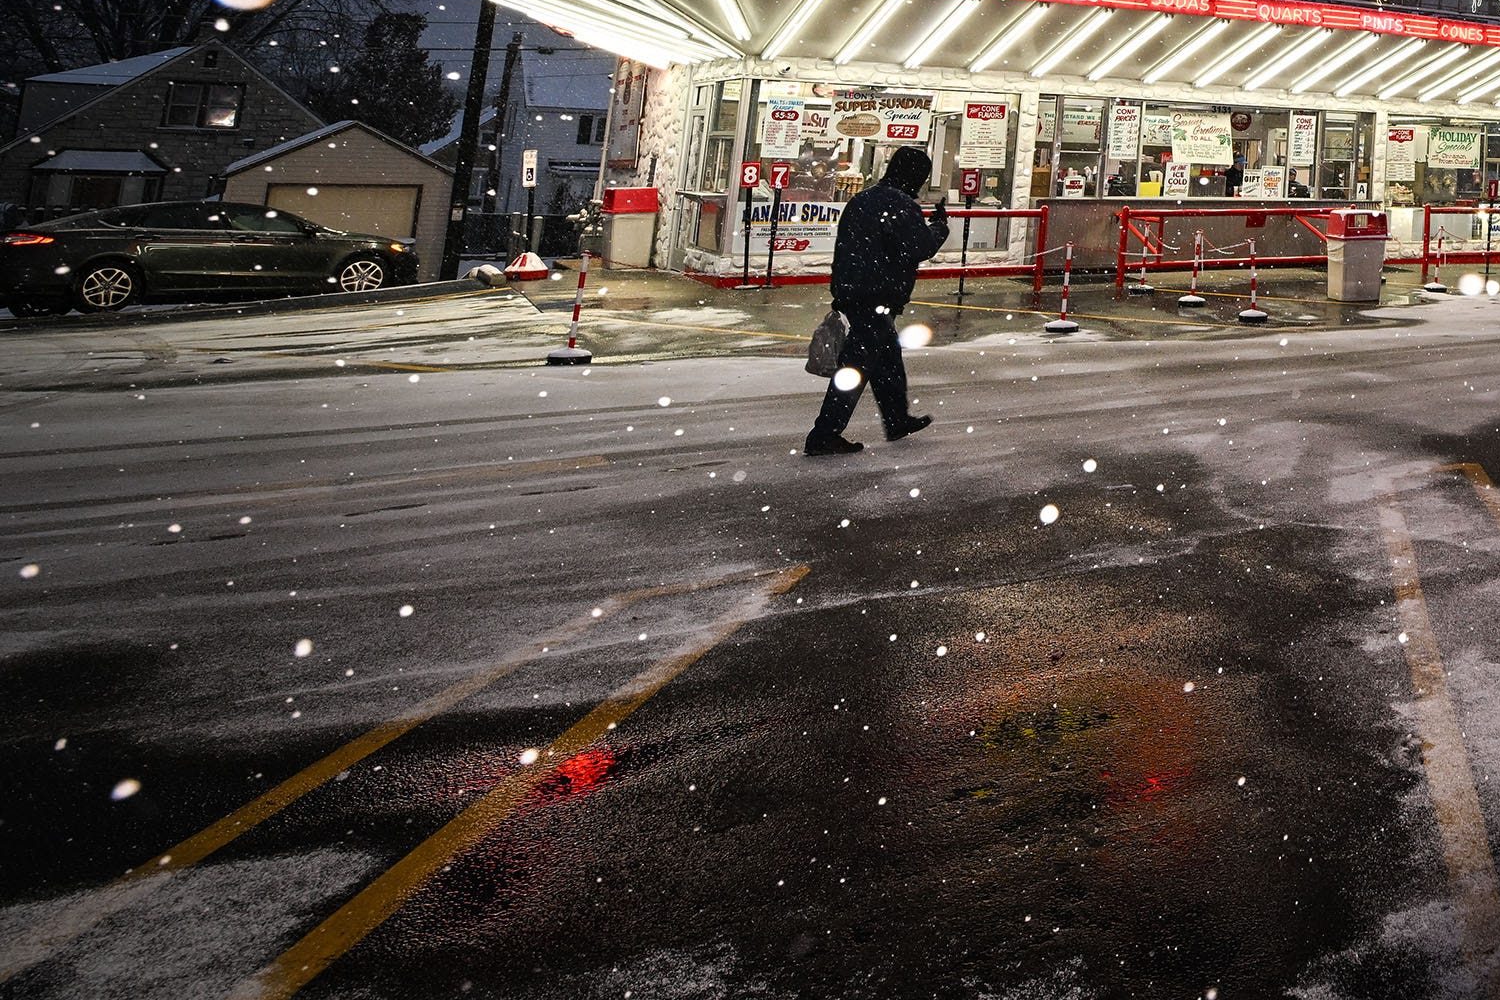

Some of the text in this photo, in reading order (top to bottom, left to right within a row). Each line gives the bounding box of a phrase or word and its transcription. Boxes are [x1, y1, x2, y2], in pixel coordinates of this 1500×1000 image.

[1258, 4, 1323, 25] QUARTS
[1362, 15, 1404, 33] PINTS
[1441, 24, 1484, 43] CONES
[844, 91, 875, 100] LEON'S
[834, 98, 932, 115] SUPER SUNDAE
[1211, 105, 1232, 114] 3131
[884, 110, 923, 122] Special
[1438, 131, 1478, 143] HOLIDAY
[743, 166, 757, 183] 8
[773, 167, 787, 186] 7
[963, 174, 977, 191] 5
[1244, 175, 1260, 183] GIFT
[1358, 184, 1365, 194] A
[801, 203, 840, 223] SPLIT
